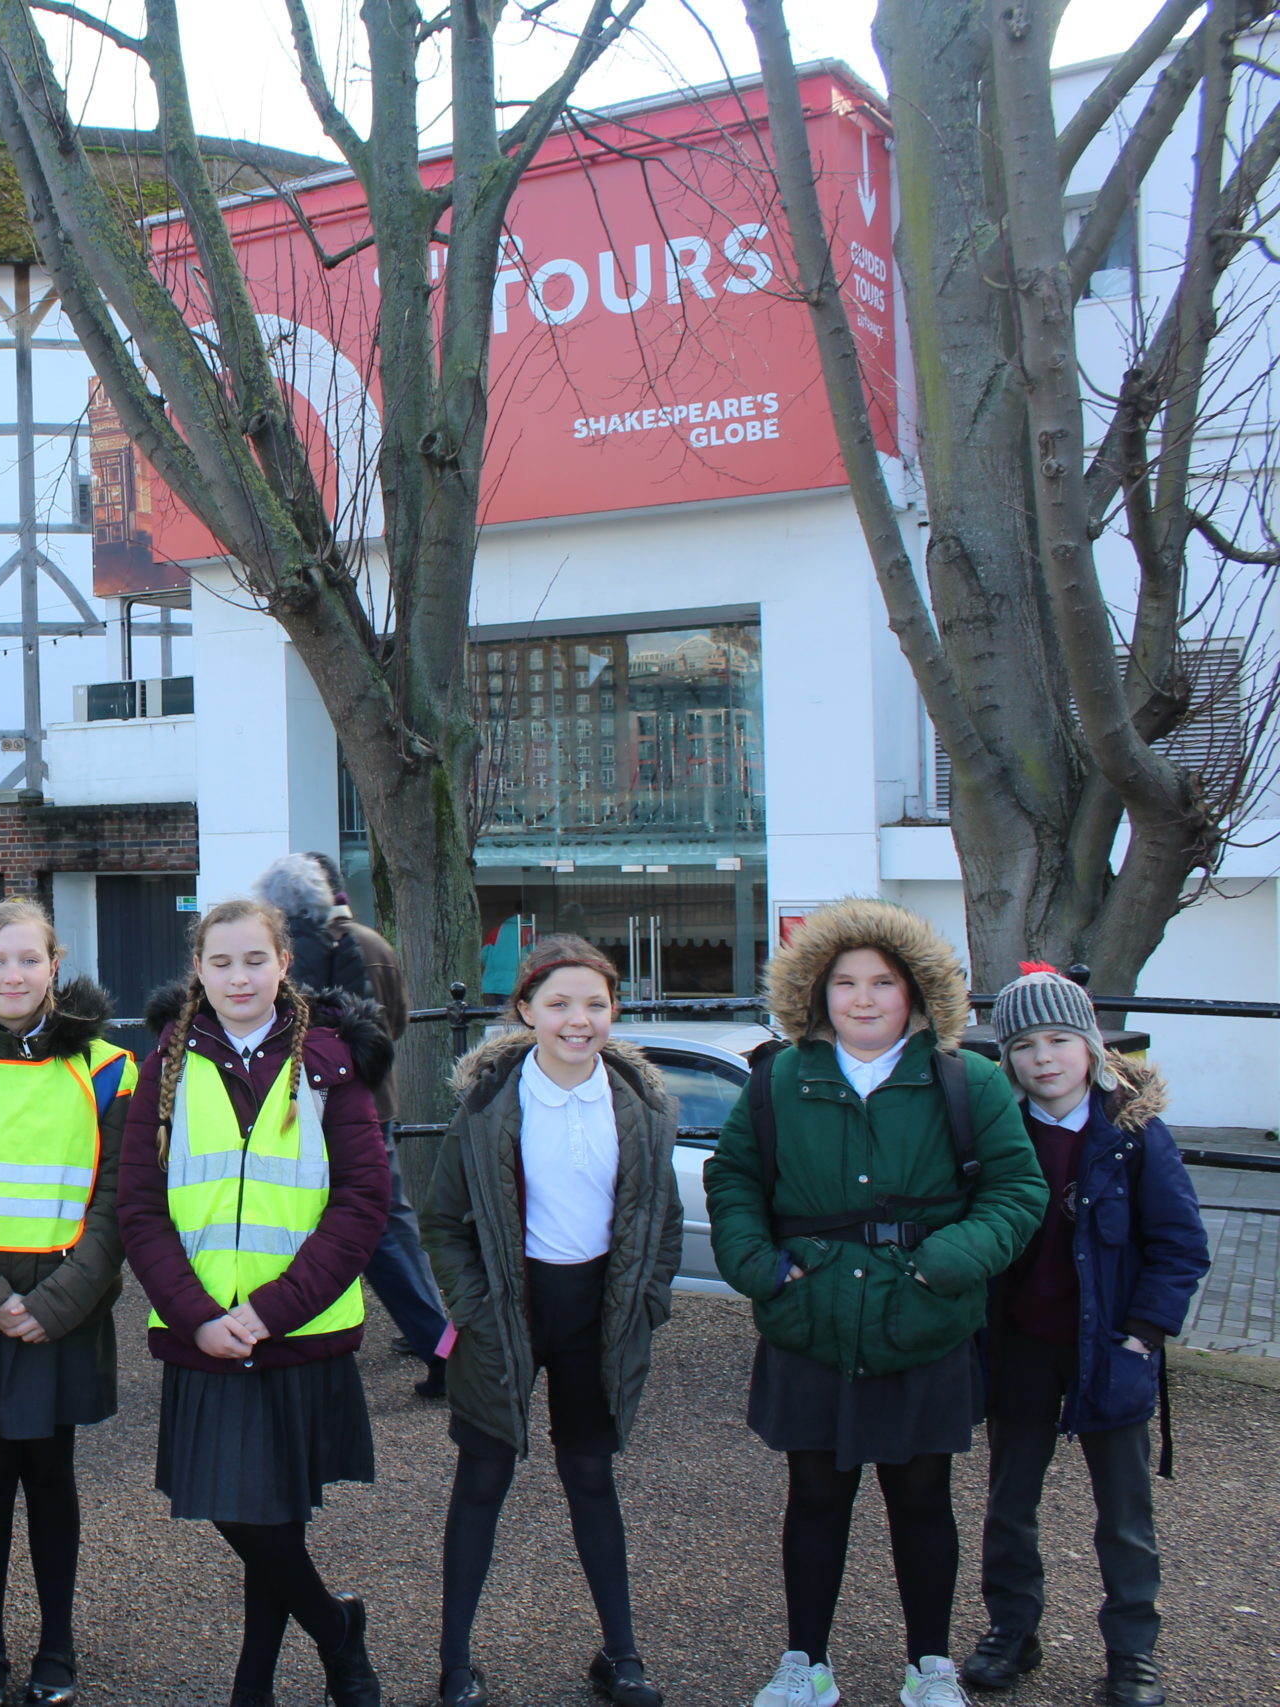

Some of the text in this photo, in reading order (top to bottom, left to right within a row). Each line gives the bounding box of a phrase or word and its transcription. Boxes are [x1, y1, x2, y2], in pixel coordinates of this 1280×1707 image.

[489, 222, 773, 335] TOURS
[850, 241, 886, 282] GUIDED
[853, 273, 885, 312] TOURS
[573, 392, 779, 439] SHAKESPEARE'S
[689, 418, 780, 448] GLOBE
